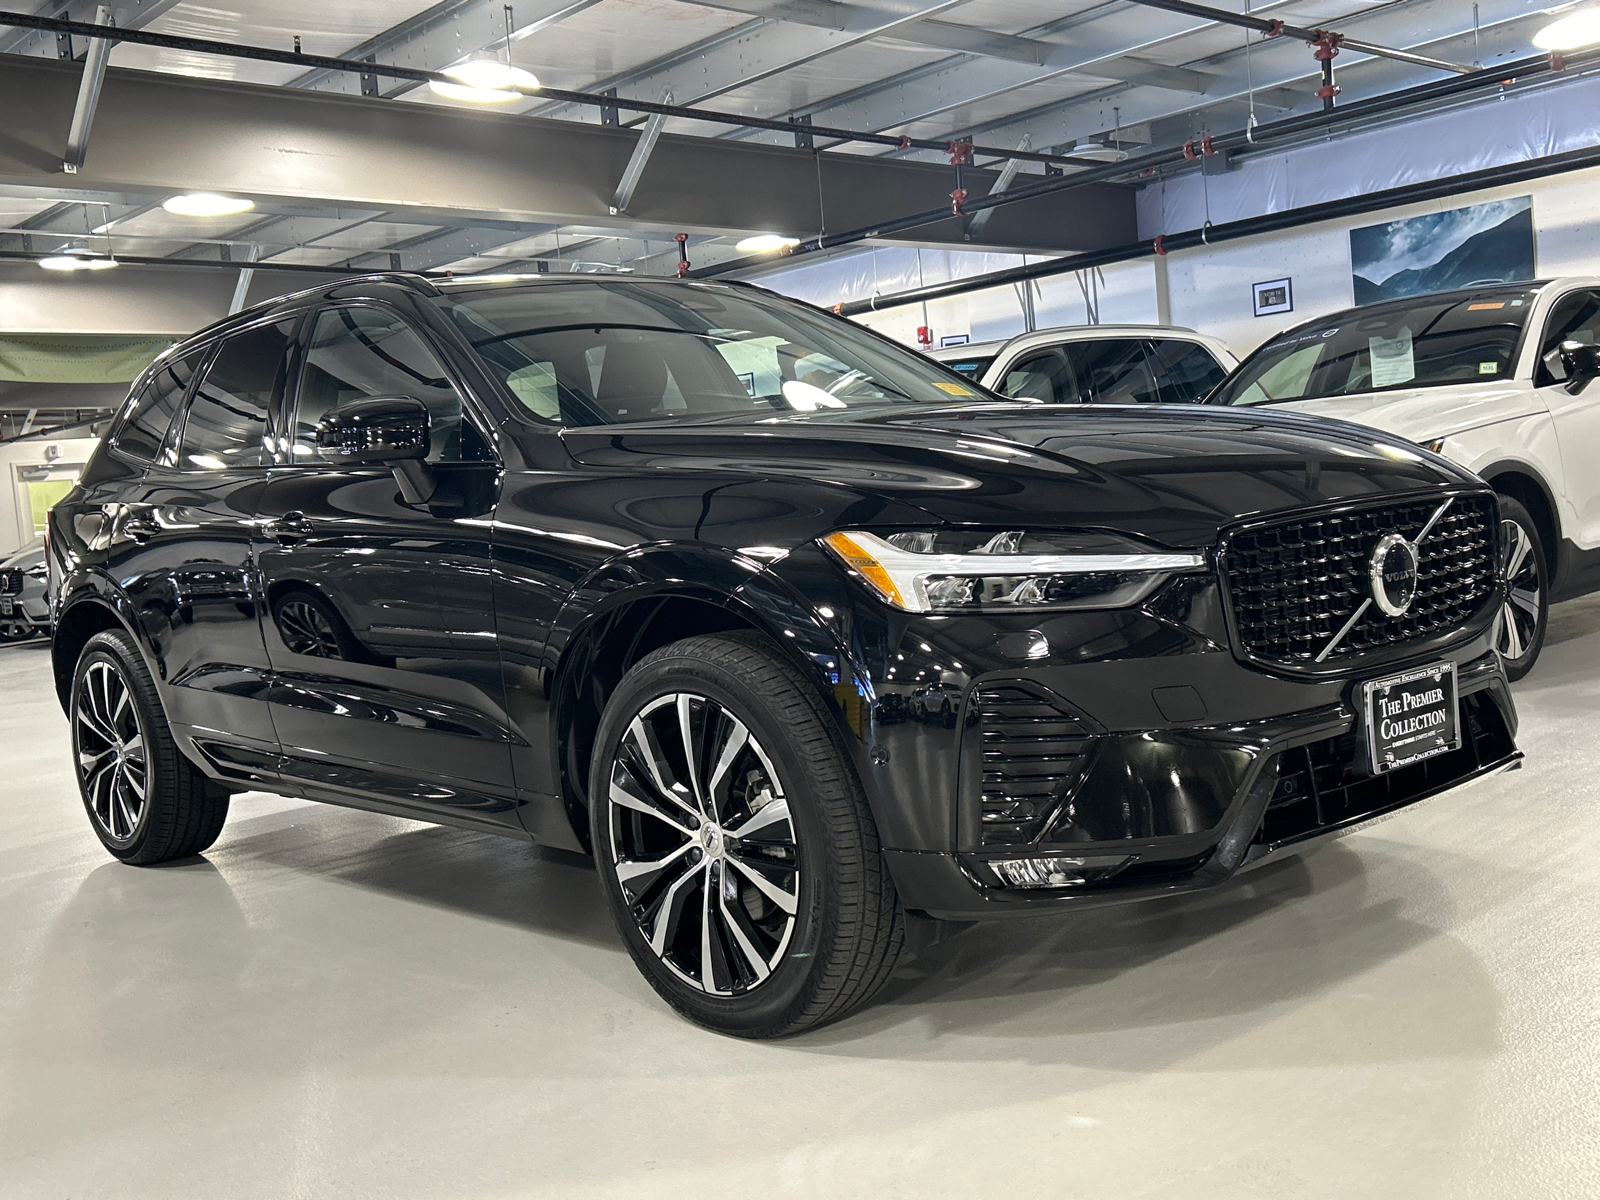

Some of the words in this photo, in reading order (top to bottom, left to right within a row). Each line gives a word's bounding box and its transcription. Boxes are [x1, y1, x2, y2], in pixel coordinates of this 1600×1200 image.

[1379, 698, 1402, 718] THE
[1402, 688, 1444, 712] PREMIER
[1381, 709, 1446, 740] COLLECTION
